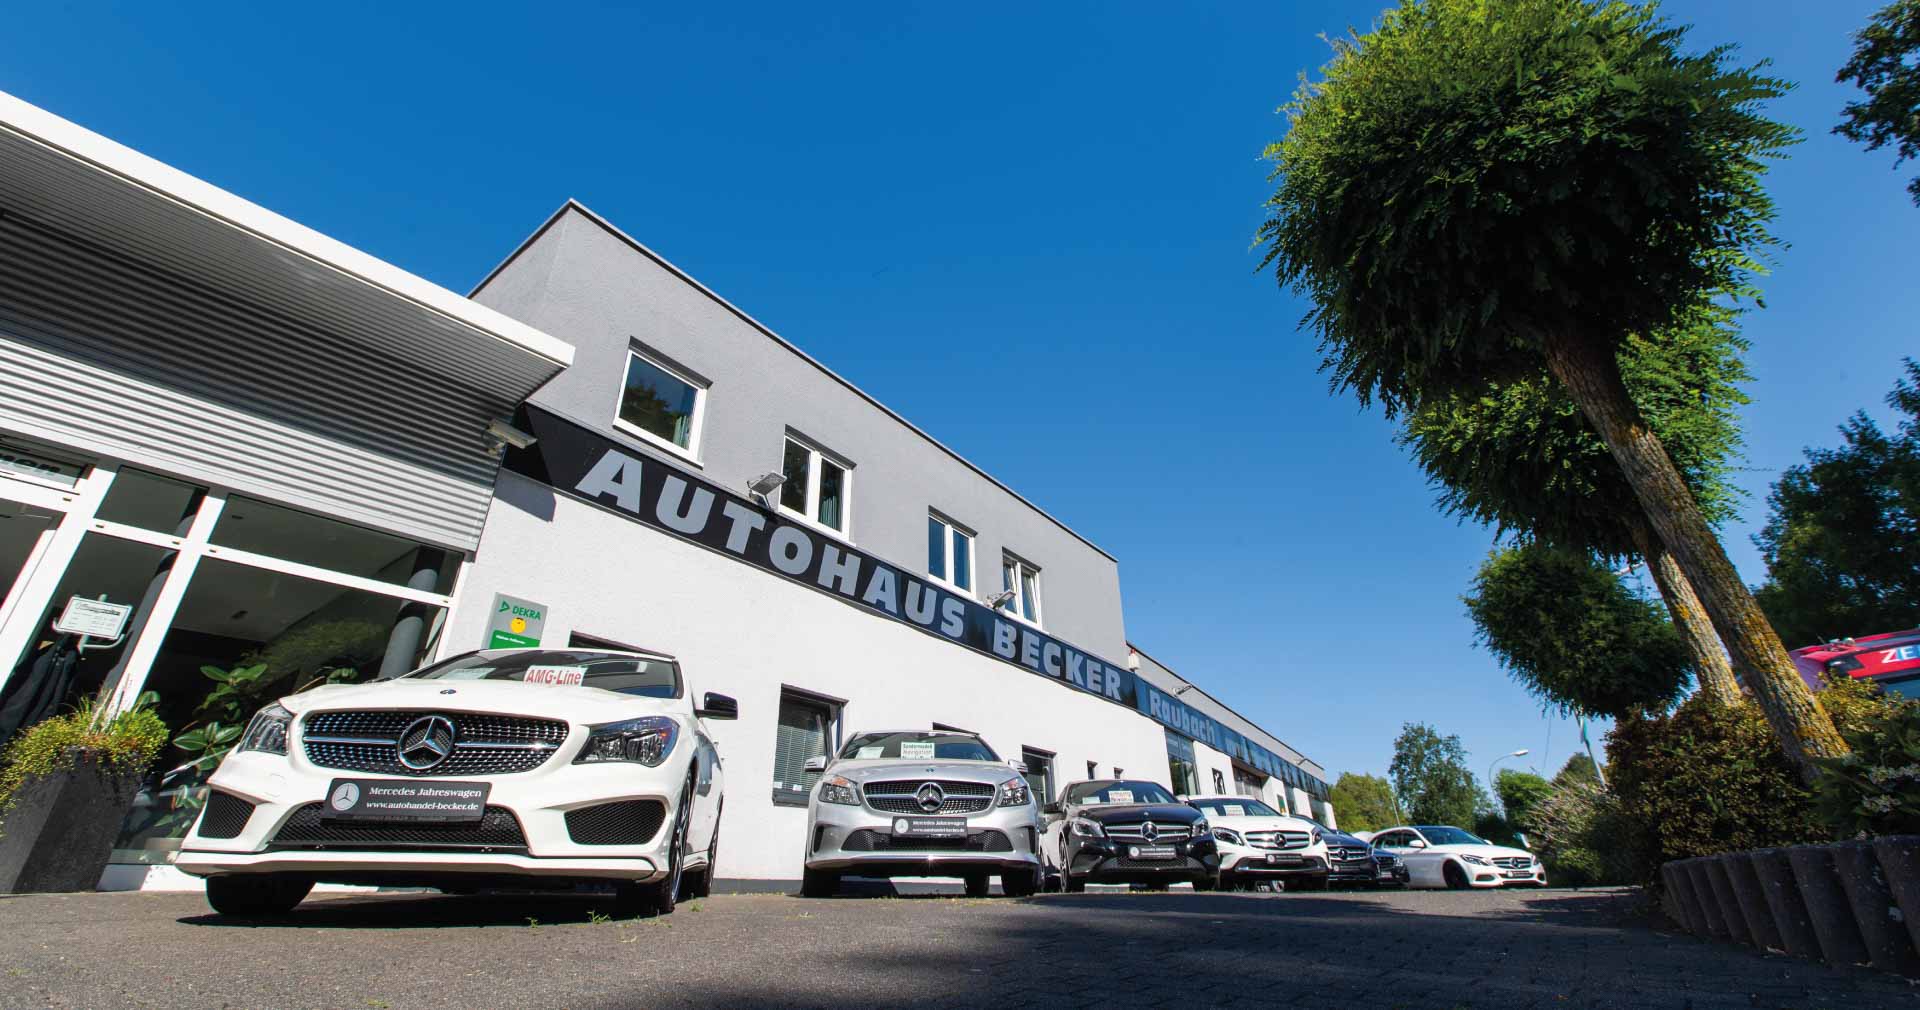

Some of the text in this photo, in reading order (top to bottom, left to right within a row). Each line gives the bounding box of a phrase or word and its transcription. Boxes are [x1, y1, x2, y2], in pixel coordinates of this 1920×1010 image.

[575, 448, 1217, 745] AUTOHAUS BECKER Raubach
[512, 605, 541, 620] DEKRA
[525, 669, 582, 685] AMG-Line
[369, 787, 482, 798] Mercedes Jahreswagen
[366, 801, 479, 811] www.autohandel-becker.de
